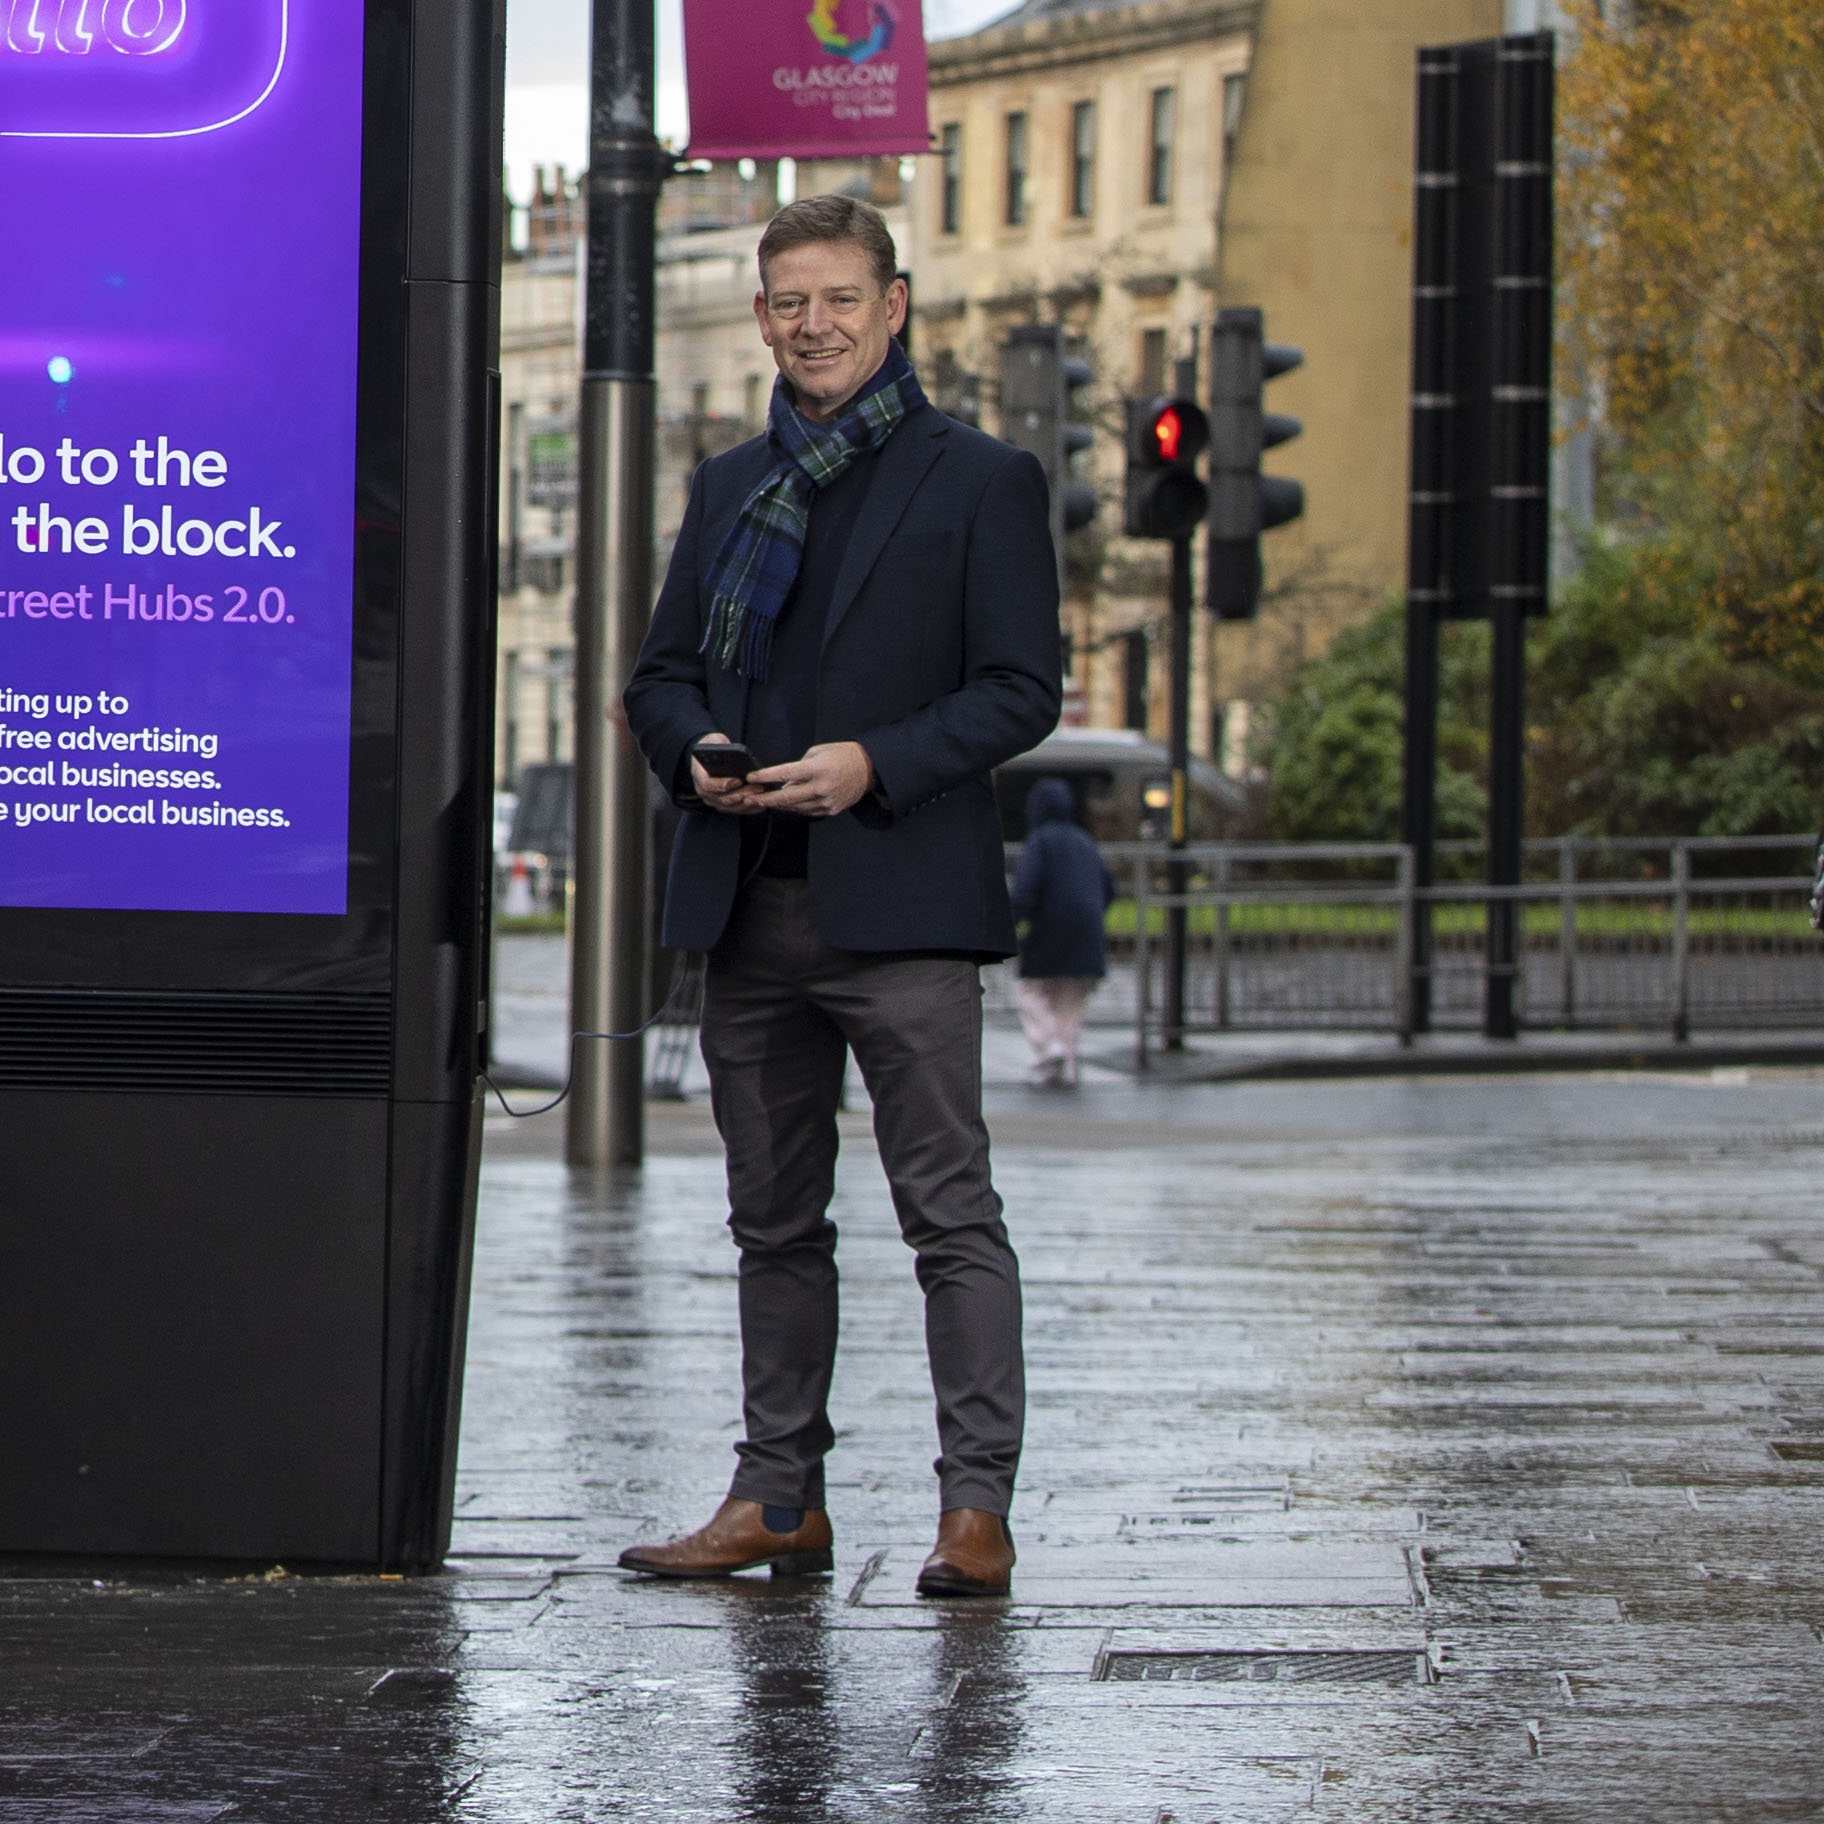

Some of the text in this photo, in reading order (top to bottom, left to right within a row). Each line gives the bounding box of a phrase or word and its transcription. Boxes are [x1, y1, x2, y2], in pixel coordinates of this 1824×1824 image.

[772, 63, 899, 90] GLASGOW
[56, 438, 118, 485] to
[130, 436, 227, 487] the
[12, 503, 109, 553] the
[123, 505, 295, 557] block.
[105, 584, 213, 621] Hubs
[224, 586, 294, 623] 2.0.
[56, 696, 92, 719] up
[97, 691, 128, 714] to
[58, 726, 217, 758] advertising
[62, 761, 221, 789] businesses.
[15, 803, 80, 826] your
[87, 798, 155, 824] local
[162, 800, 290, 827] business.
